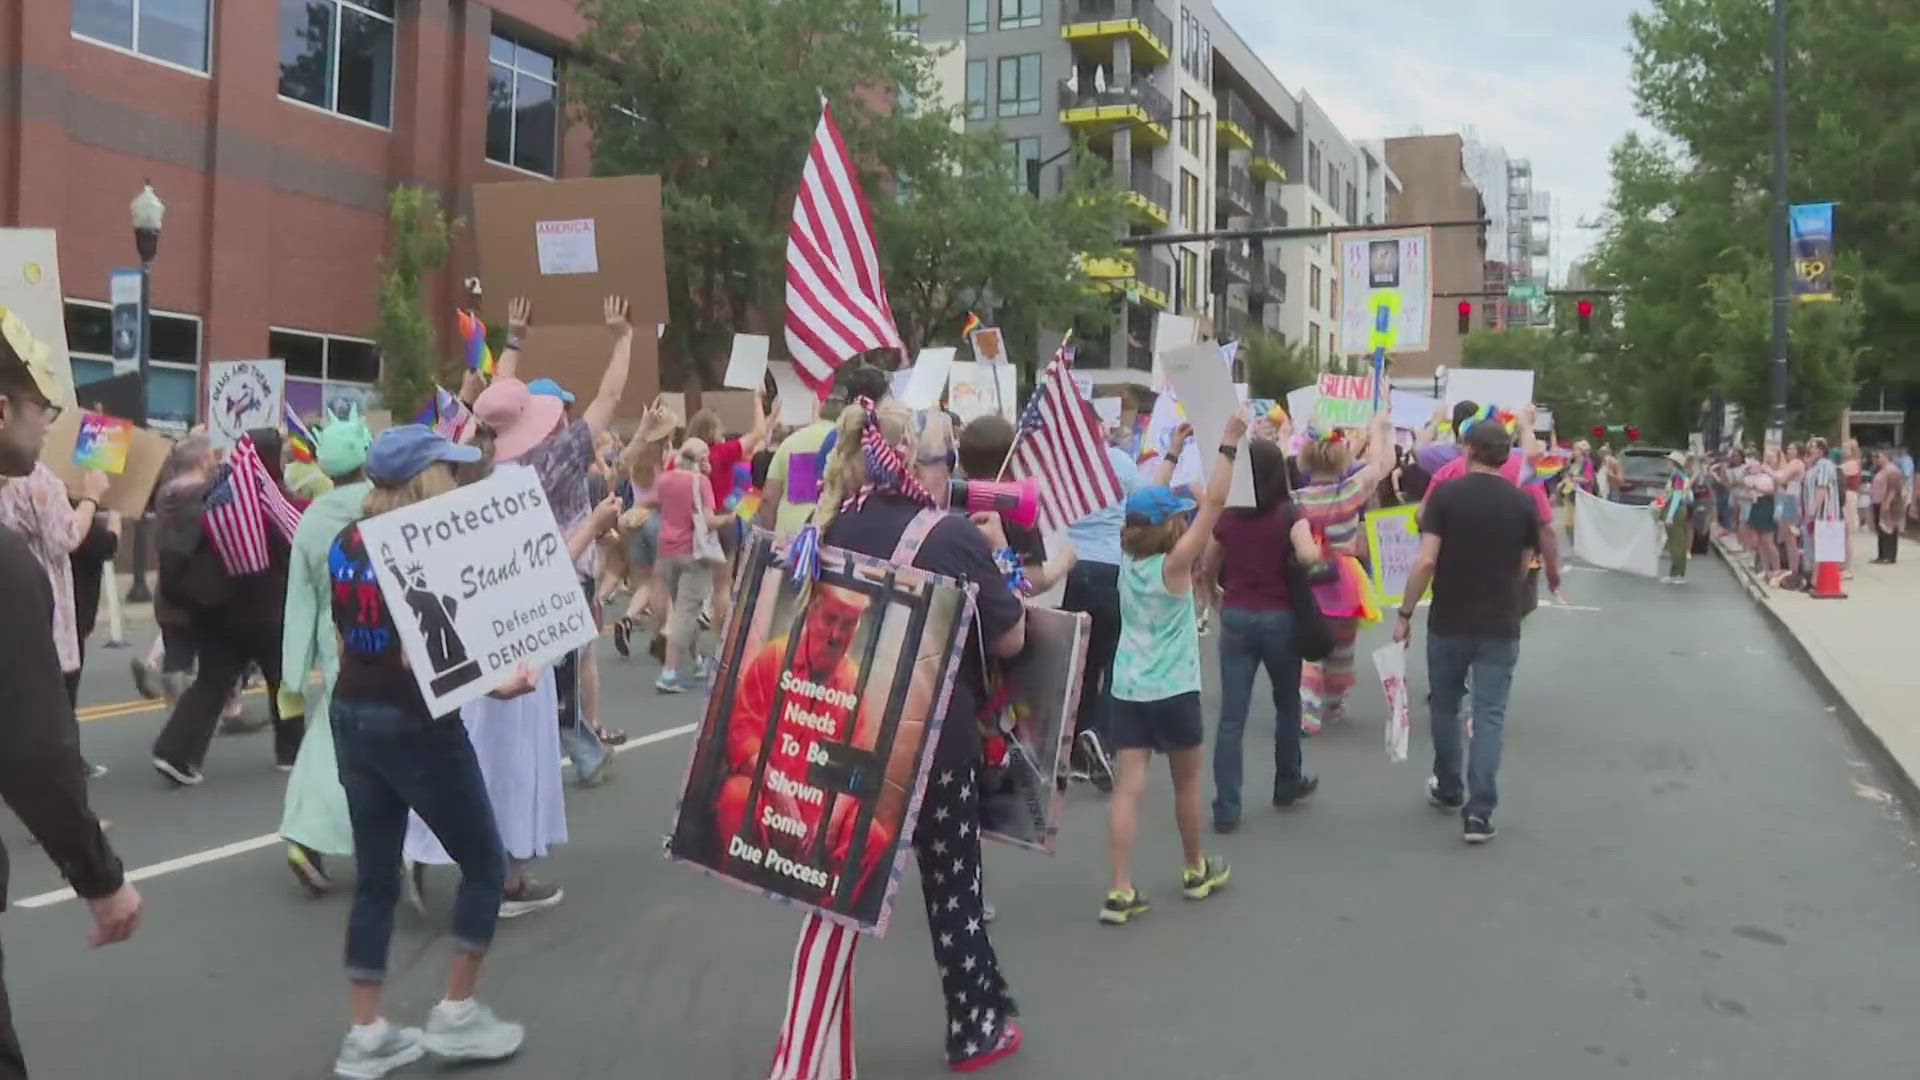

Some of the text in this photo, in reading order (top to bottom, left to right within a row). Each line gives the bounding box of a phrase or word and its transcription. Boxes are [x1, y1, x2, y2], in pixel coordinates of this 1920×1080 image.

[401, 487, 542, 553] Protectors
[459, 548, 521, 600] Stand
[492, 589, 577, 638] Defend Our
[487, 611, 586, 671] DEMOCRACY
[780, 669, 857, 711] Someone
[784, 702, 836, 735] Needs
[781, 733, 829, 767] To Be
[766, 769, 824, 805] Shown
[762, 806, 808, 838] Some
[728, 834, 762, 865] Due
[764, 848, 829, 889] Process
